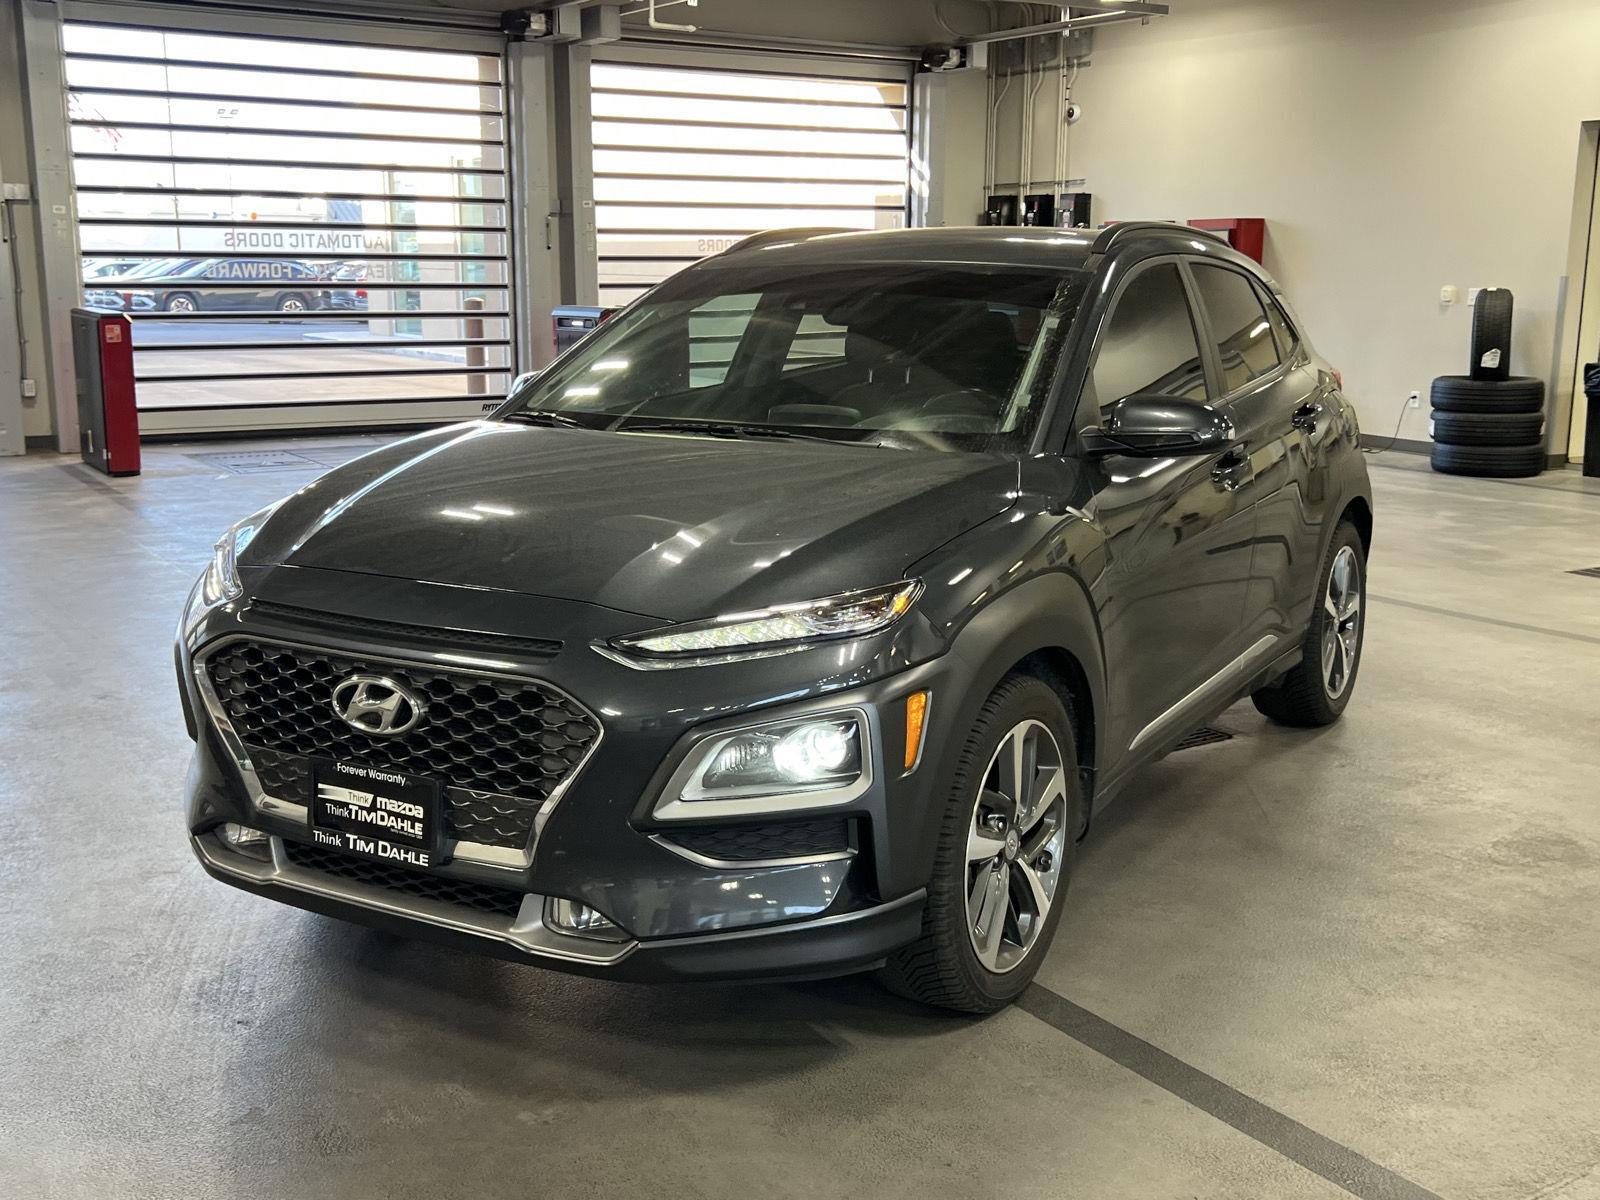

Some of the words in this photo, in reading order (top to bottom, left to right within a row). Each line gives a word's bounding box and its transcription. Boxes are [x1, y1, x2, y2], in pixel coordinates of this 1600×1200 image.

[336, 762, 367, 778] Forever
[368, 768, 406, 786] Warranty
[325, 802, 350, 818] Think
[348, 791, 370, 804] Think
[376, 796, 424, 819] mazda
[313, 830, 342, 847] Think
[345, 833, 374, 854] TIM
[378, 840, 429, 867] DAHLE
